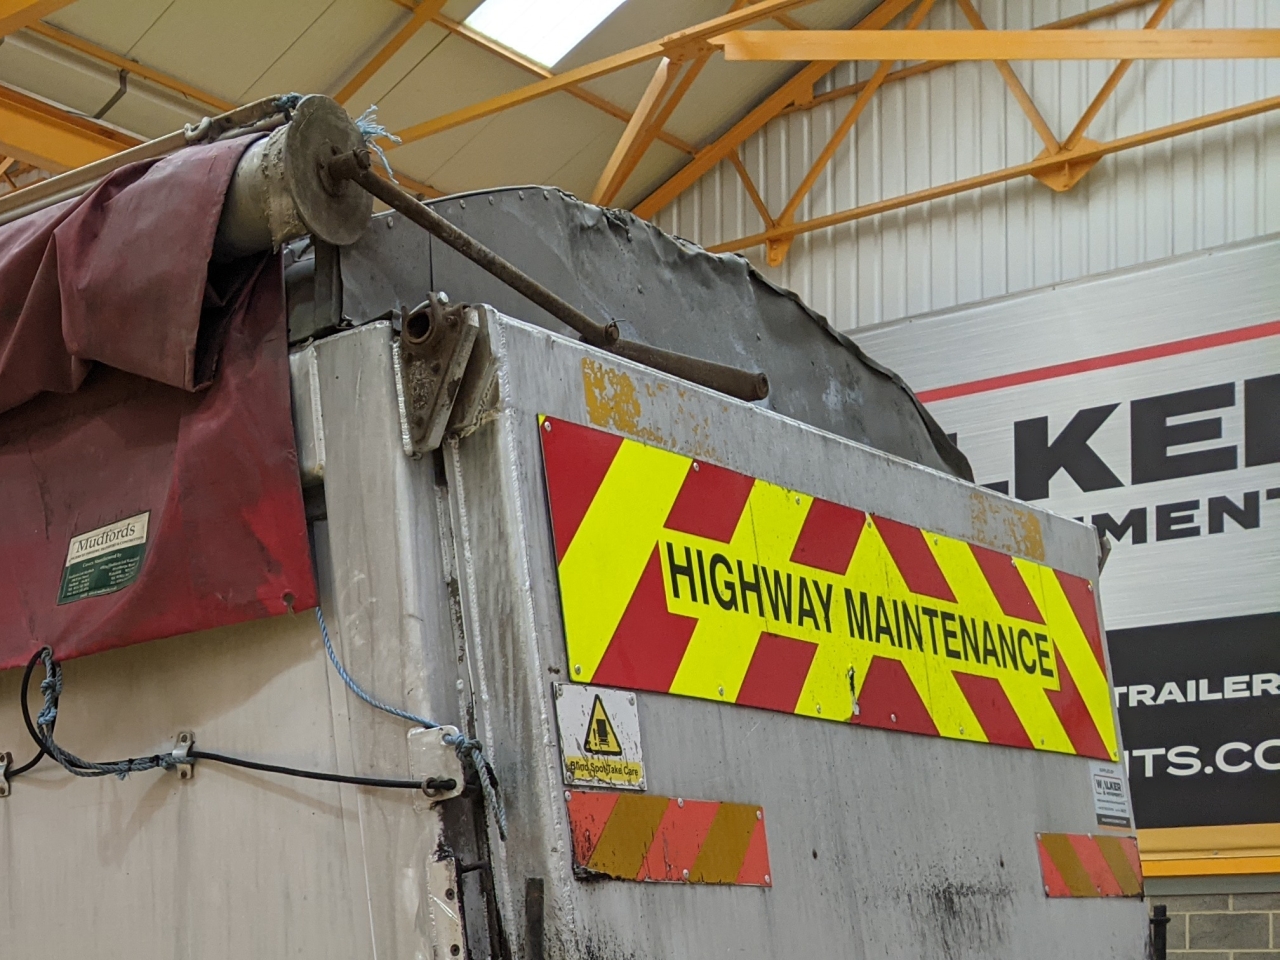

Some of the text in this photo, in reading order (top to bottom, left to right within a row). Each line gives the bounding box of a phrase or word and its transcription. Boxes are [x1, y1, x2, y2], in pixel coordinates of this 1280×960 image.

[76, 523, 136, 553] Mudfords
[666, 542, 1054, 679] HIGHWAY MAINTENANCE
[570, 761, 589, 772] Blind
[606, 764, 622, 775] Take
[624, 765, 639, 777] Care
[1124, 739, 1280, 778] TS.CO
[1095, 779, 1122, 792] WALKER
